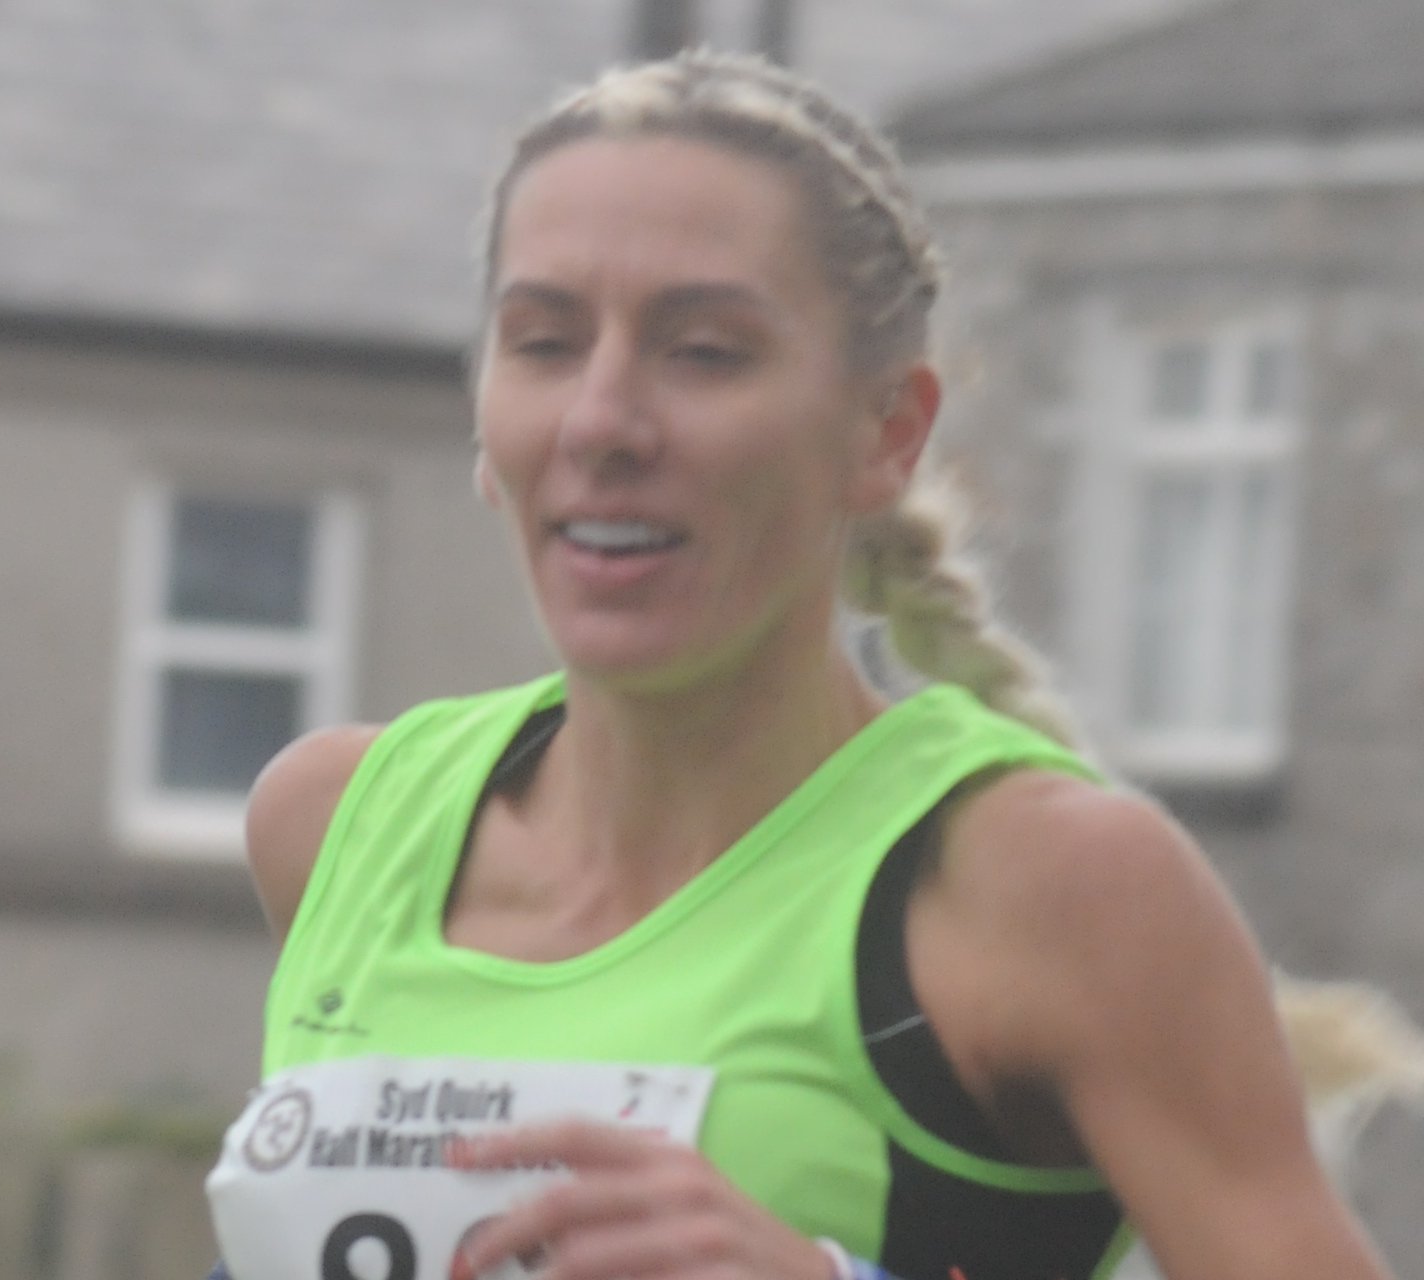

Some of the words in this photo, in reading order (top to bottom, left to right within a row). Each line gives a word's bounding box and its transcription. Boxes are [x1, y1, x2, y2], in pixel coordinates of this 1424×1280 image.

[377, 1079, 430, 1124] Syd
[436, 1079, 513, 1123] Quirk
[307, 1126, 363, 1168] Half
